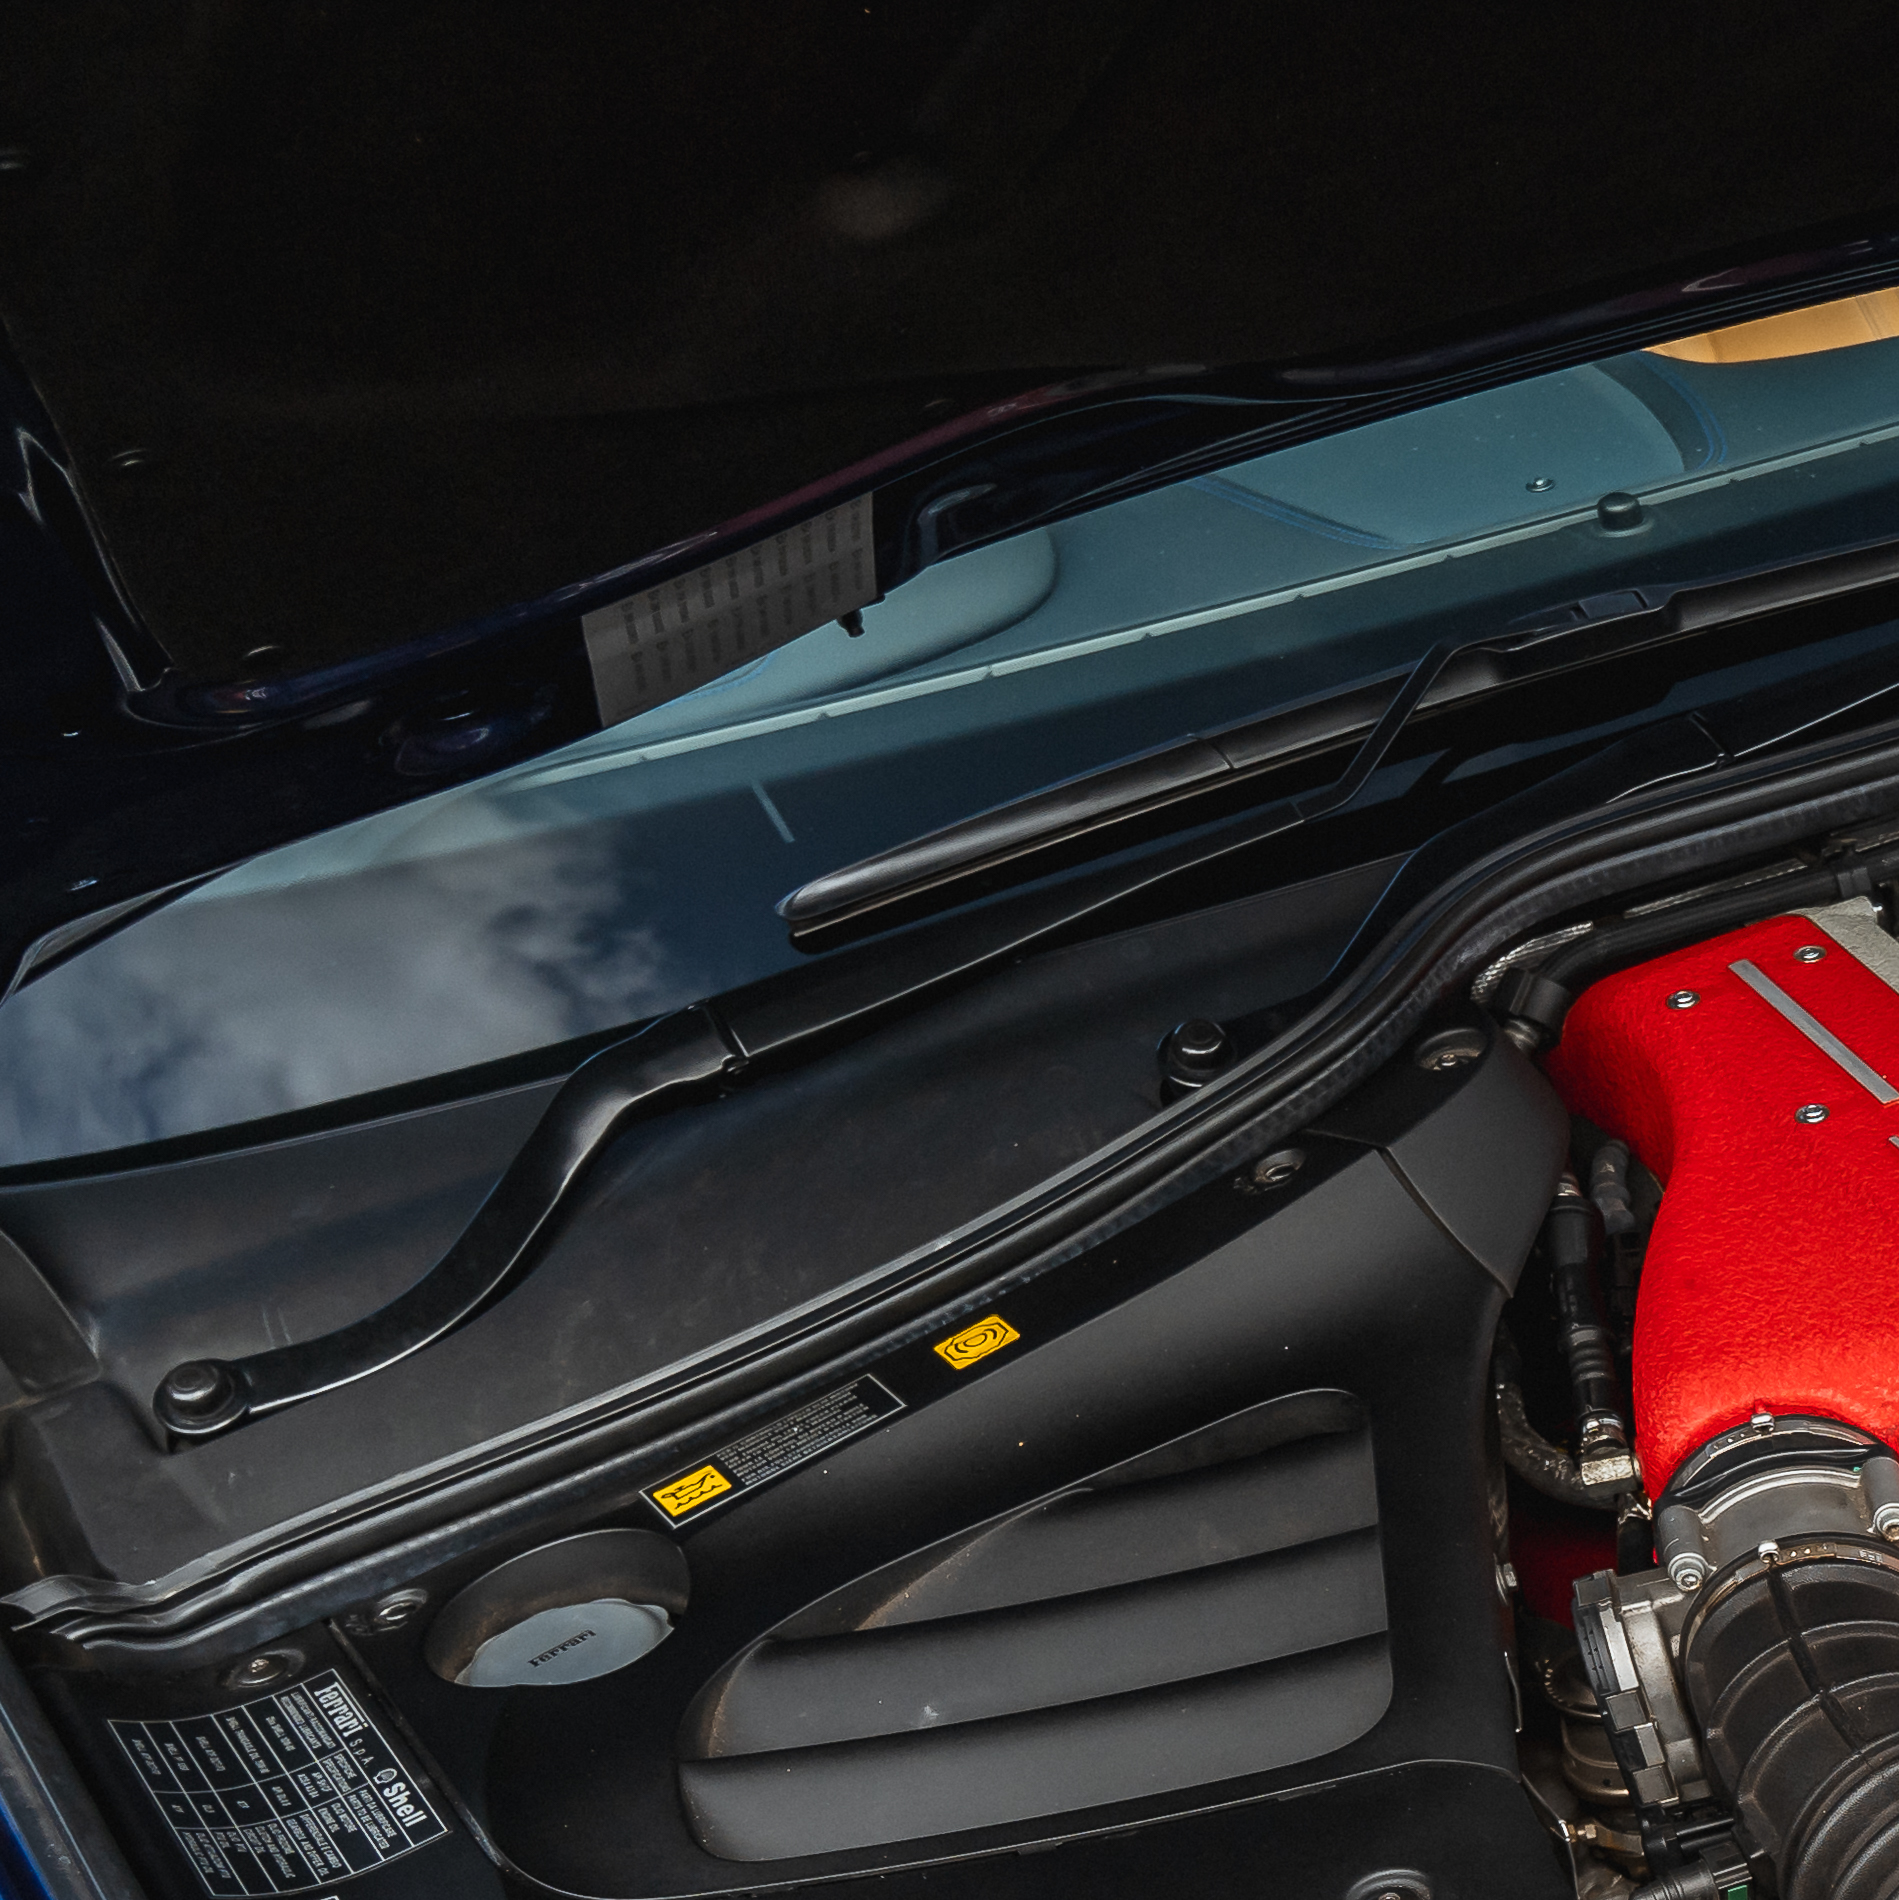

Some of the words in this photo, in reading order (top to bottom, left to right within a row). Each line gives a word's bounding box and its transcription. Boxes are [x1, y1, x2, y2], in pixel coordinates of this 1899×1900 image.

[528, 1629, 597, 1667] Ferrari
[314, 1682, 367, 1736] Ferrari
[383, 1782, 426, 1826] Shell
